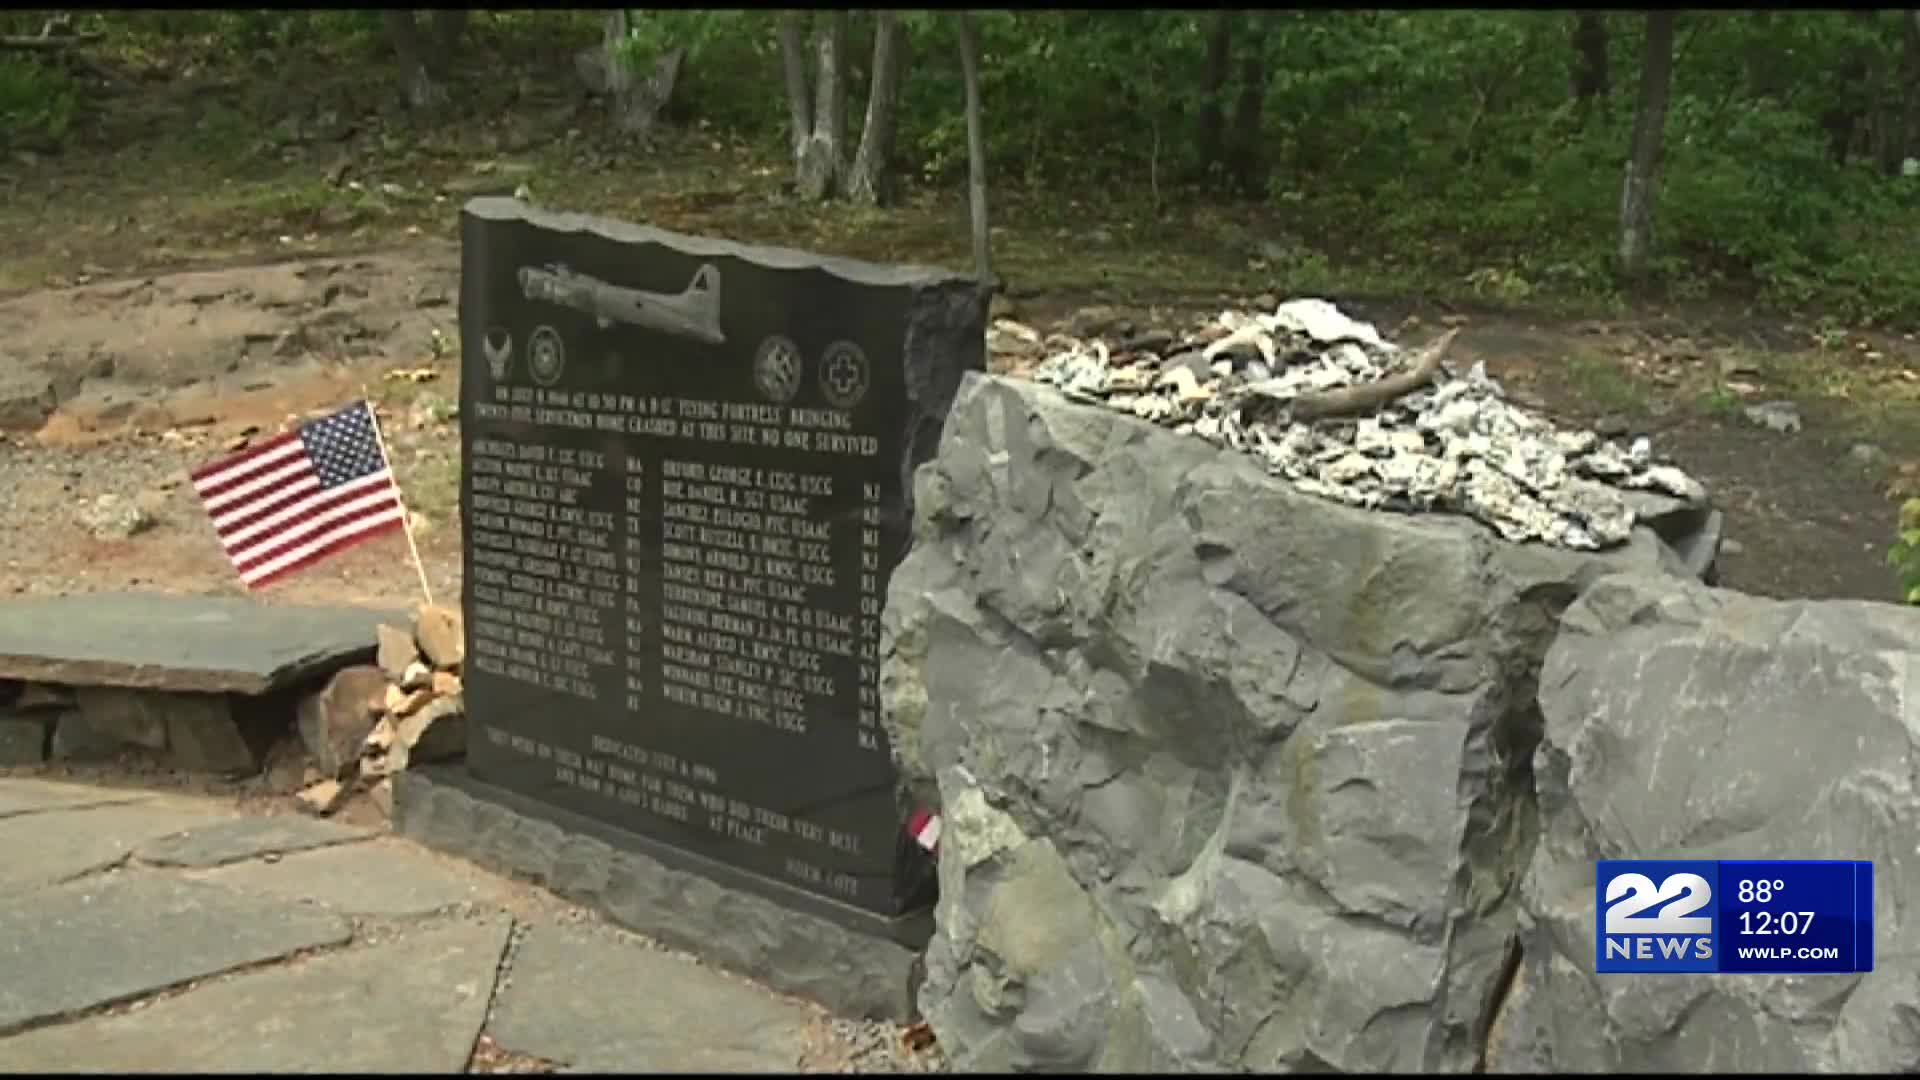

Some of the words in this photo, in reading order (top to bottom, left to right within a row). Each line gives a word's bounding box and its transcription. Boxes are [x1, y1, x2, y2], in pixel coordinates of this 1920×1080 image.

[628, 415, 676, 436] CRASHED
[699, 422, 726, 441] THIS
[783, 429, 808, 449] ONE
[708, 465, 752, 485] GEORGE
[799, 475, 832, 495] USCG
[768, 493, 808, 514] USAAC
[791, 518, 830, 540] USAAC
[799, 542, 830, 562] USCG
[802, 564, 836, 586] USCG
[768, 580, 807, 603] USAAC
[814, 610, 851, 634] USAAC
[814, 633, 851, 656] USAAC
[788, 649, 820, 672] USCG
[803, 674, 835, 697] USCG
[772, 689, 804, 712] USCG
[792, 818, 824, 845] VERY
